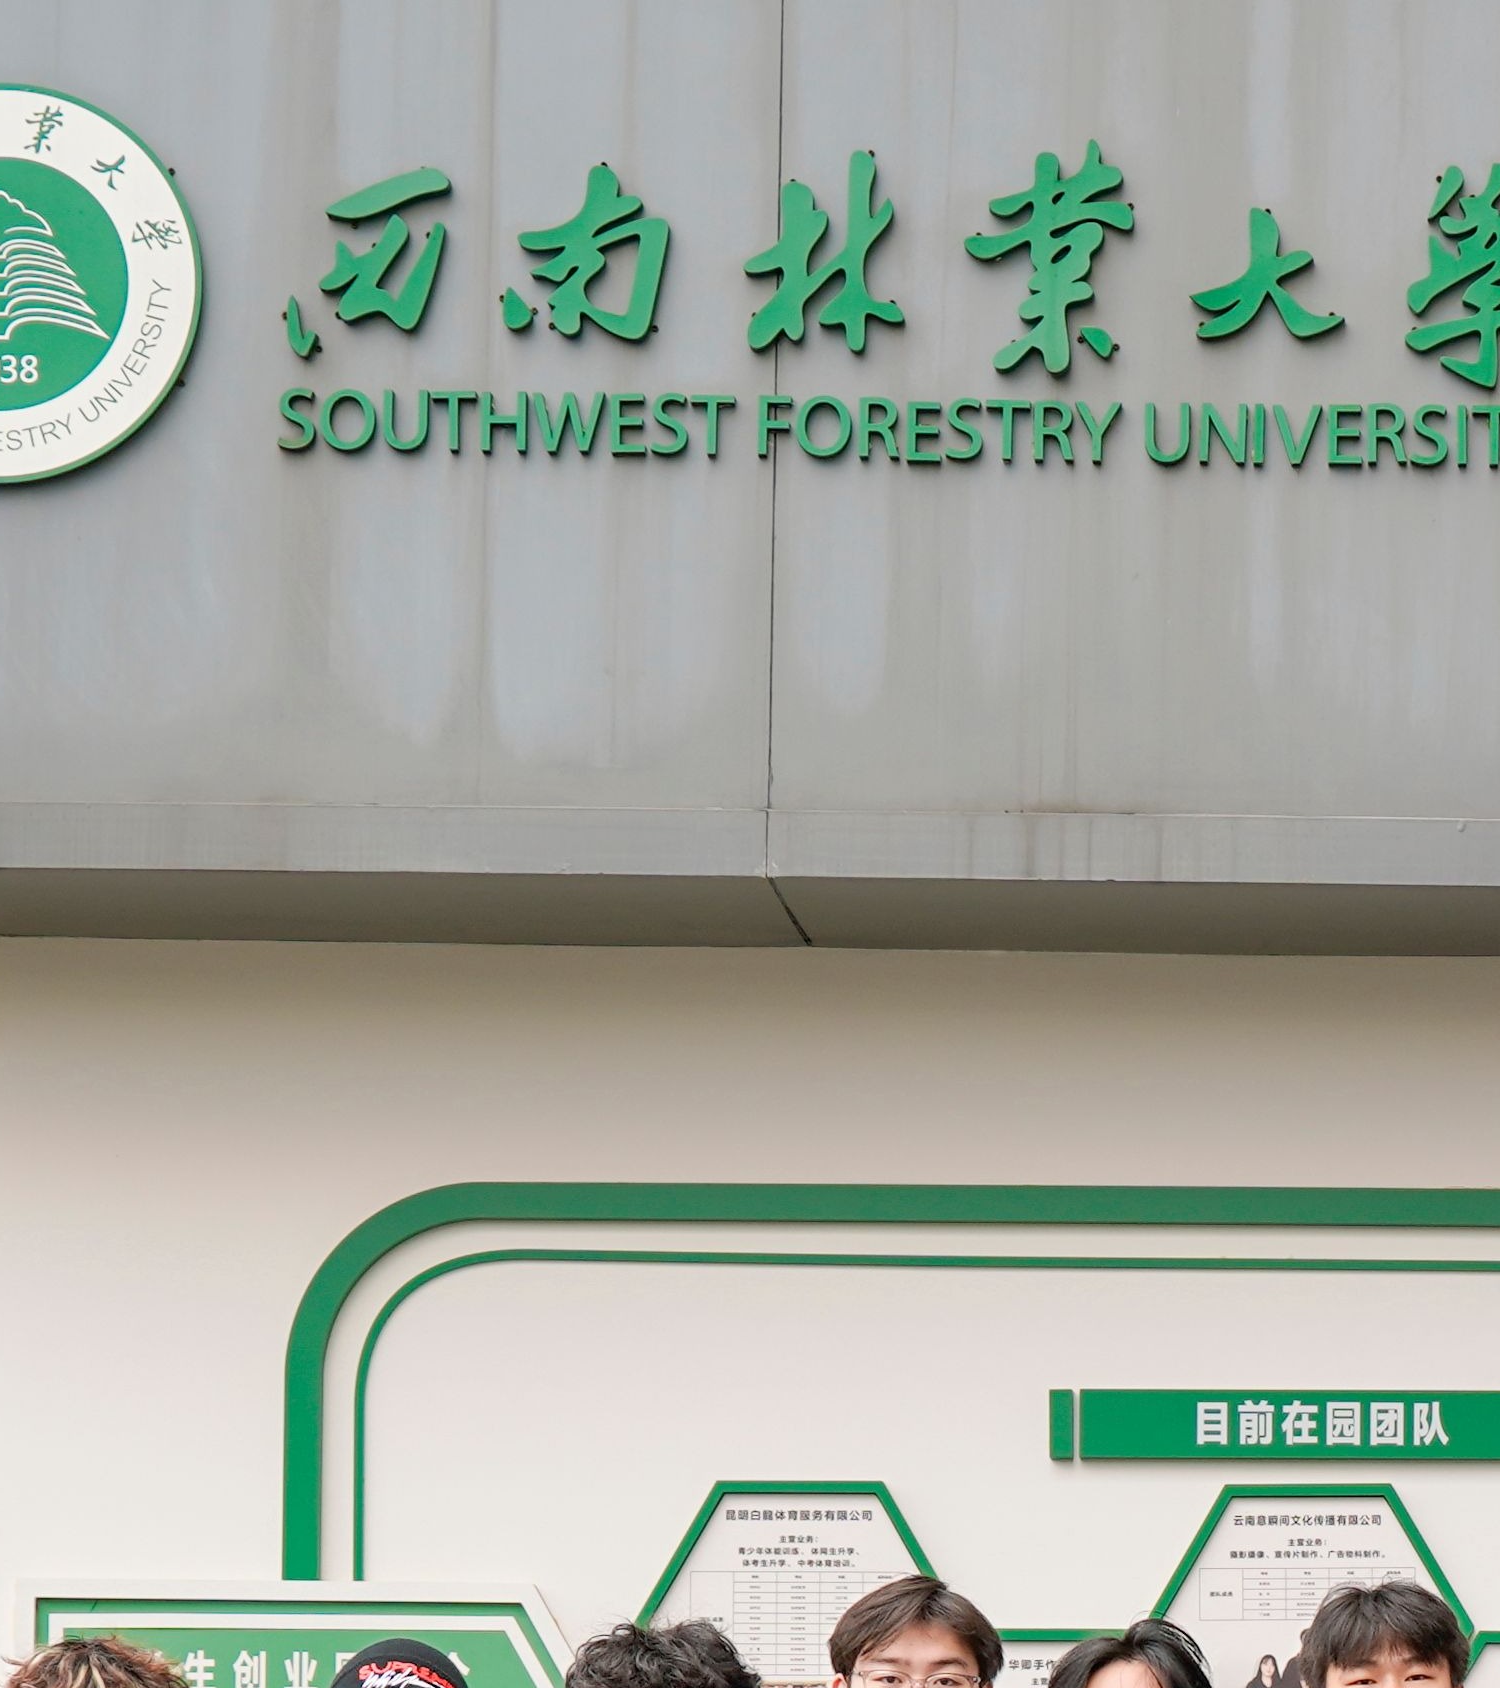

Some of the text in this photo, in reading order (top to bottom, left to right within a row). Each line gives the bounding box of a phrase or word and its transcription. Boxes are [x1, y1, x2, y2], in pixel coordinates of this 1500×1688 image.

[78, 279, 173, 424] UNIVERSITY
[278, 388, 737, 462] SOUTHWEST
[754, 396, 1126, 465] FORESTRY
[1195, 1400, 1451, 1447] 目前在园团队
